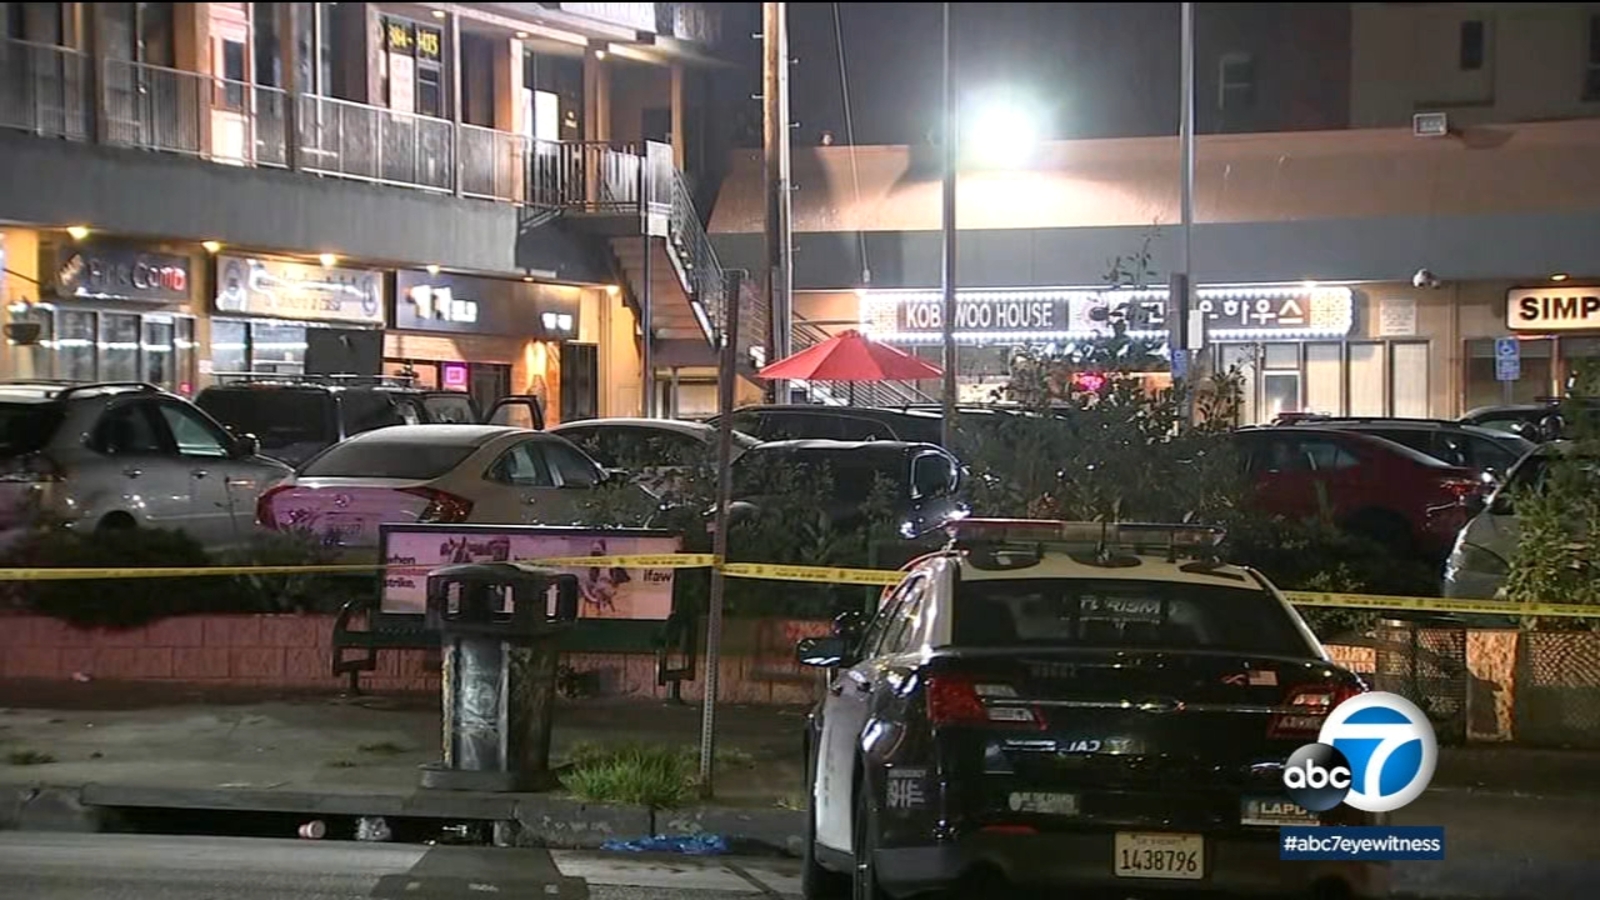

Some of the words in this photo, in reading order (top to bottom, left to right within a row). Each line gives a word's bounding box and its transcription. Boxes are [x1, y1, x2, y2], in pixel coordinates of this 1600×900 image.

[996, 302, 1053, 327] HOUSE
[1519, 297, 1600, 320] SIMP
[1120, 849, 1198, 872] 1438796
